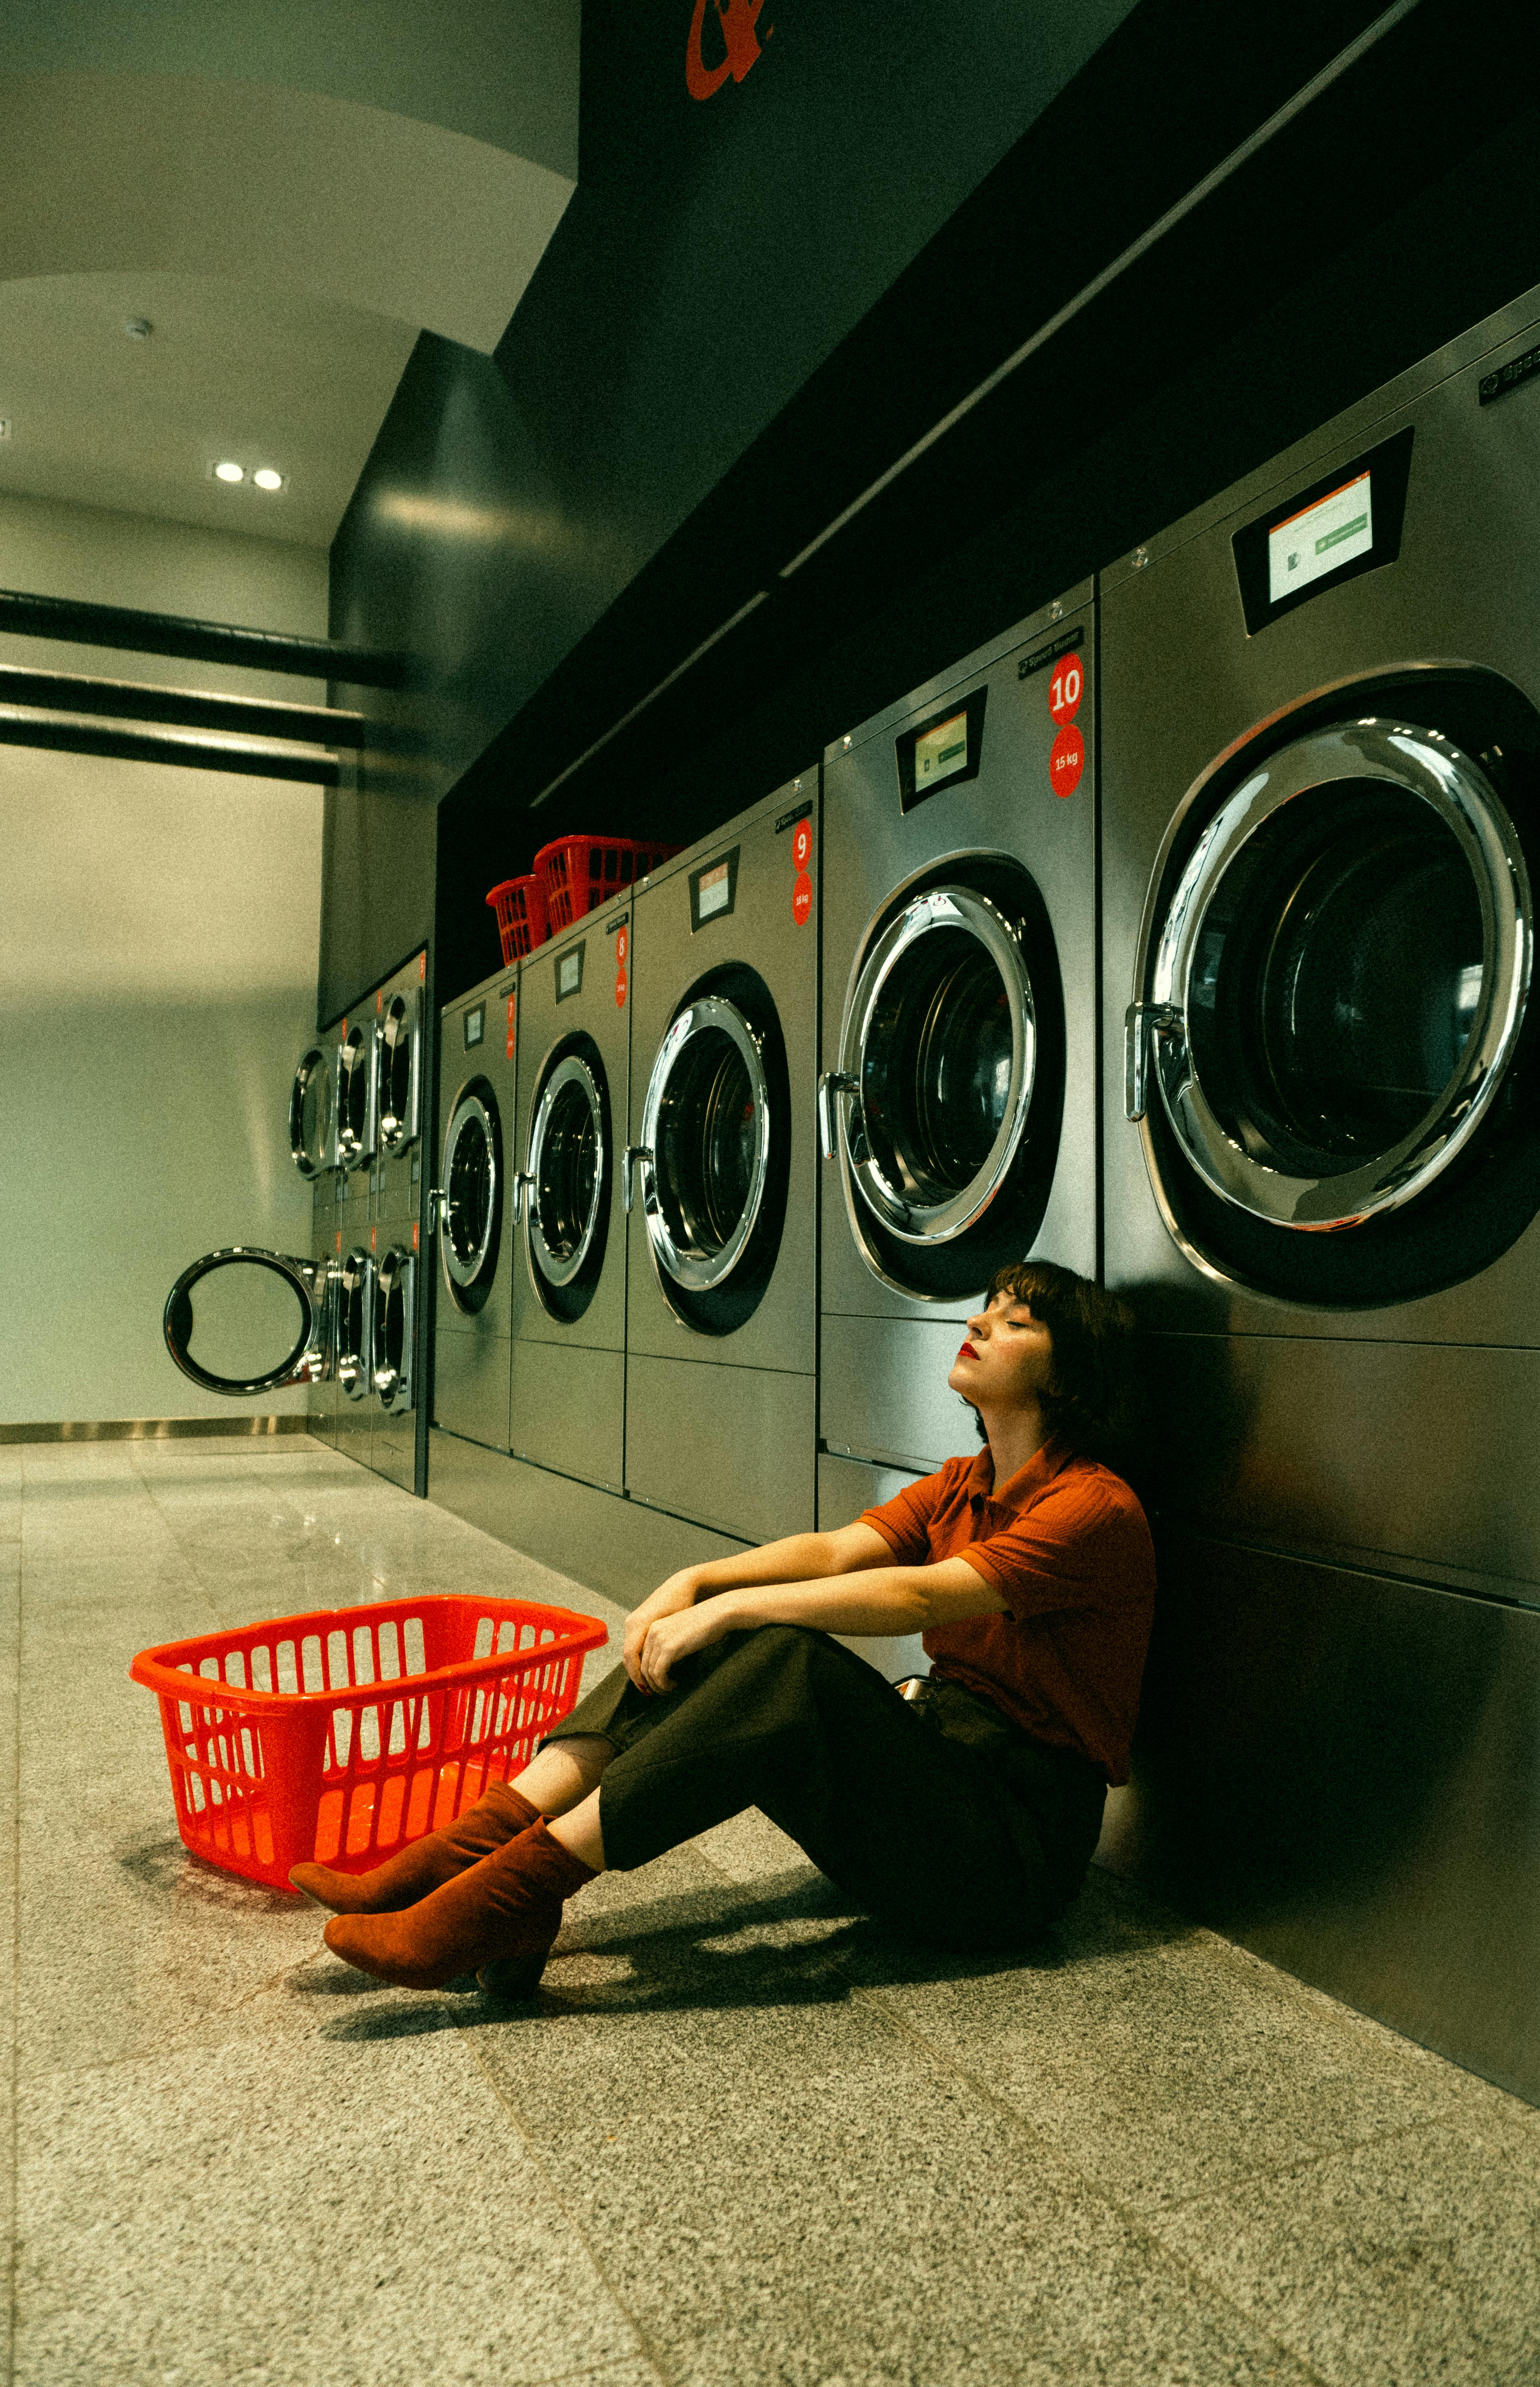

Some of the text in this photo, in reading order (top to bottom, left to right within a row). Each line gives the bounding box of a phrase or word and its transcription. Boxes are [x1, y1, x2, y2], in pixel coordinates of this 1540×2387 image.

[1052, 669, 1080, 712] 10
[1055, 752, 1078, 771] 15 kg
[797, 833, 806, 859] 9
[796, 894, 809, 906] 18 kg
[619, 936, 624, 956] 8
[509, 1001, 513, 1018] 7
